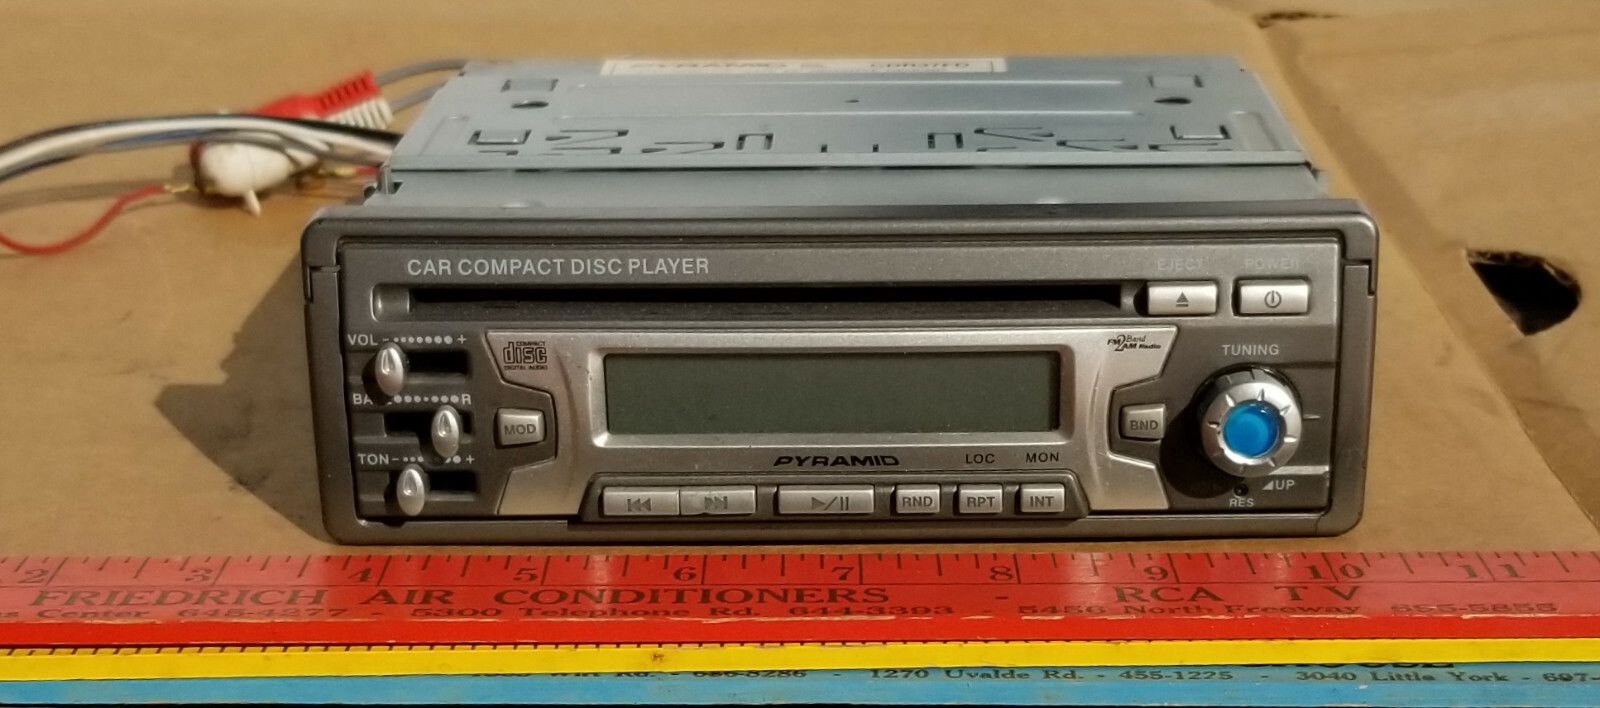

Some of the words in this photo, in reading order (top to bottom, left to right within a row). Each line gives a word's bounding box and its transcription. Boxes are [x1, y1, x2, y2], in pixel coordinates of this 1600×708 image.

[407, 258, 452, 276] CAR
[457, 258, 564, 276] COMPACT
[571, 258, 623, 275] DISC
[628, 257, 710, 275] PLAYER
[1157, 257, 1204, 271] EJECT
[1244, 257, 1300, 271] POWER
[347, 333, 379, 346] VOL
[1126, 334, 1147, 343] Band
[1222, 344, 1280, 356] TUNING
[461, 393, 472, 405] R
[503, 422, 537, 436] MOD
[1129, 420, 1159, 431] BND
[357, 453, 390, 465] TON
[773, 455, 900, 467] PYRAMID
[965, 453, 996, 465] LOC
[1025, 452, 1060, 463] MON
[1275, 479, 1296, 490] UP
[901, 496, 933, 508] RND
[966, 496, 996, 508] RPT
[1029, 495, 1055, 507] INT
[1229, 497, 1255, 508] RES
[17, 569, 49, 584] 2
[185, 568, 214, 583] 3
[347, 568, 374, 583] 4
[513, 567, 538, 583] 5
[673, 566, 697, 582] 6
[832, 566, 854, 581] 7
[989, 565, 1013, 581] 8
[1144, 565, 1168, 581] 9
[28, 589, 330, 606] FRIEDRICH
[360, 588, 454, 605] AIR
[494, 587, 889, 605] CONDITIONERS
[1114, 586, 1224, 603] RCA
[36, 608, 151, 619] Center
[410, 607, 502, 617] 5300
[518, 606, 690, 619] Telephone
[708, 606, 761, 617] Rd.
[1018, 605, 1106, 615] 5456
[1123, 605, 1212, 615] North
[1224, 603, 1361, 616] Freeway
[871, 669, 930, 679] 1270
[945, 669, 1030, 679] Uvalde
[1042, 669, 1084, 680] Rd.
[1118, 670, 1234, 681] 455-1275
[1296, 671, 1358, 681] 3040
[1370, 671, 1434, 682] Little
[1448, 671, 1510, 682] York
